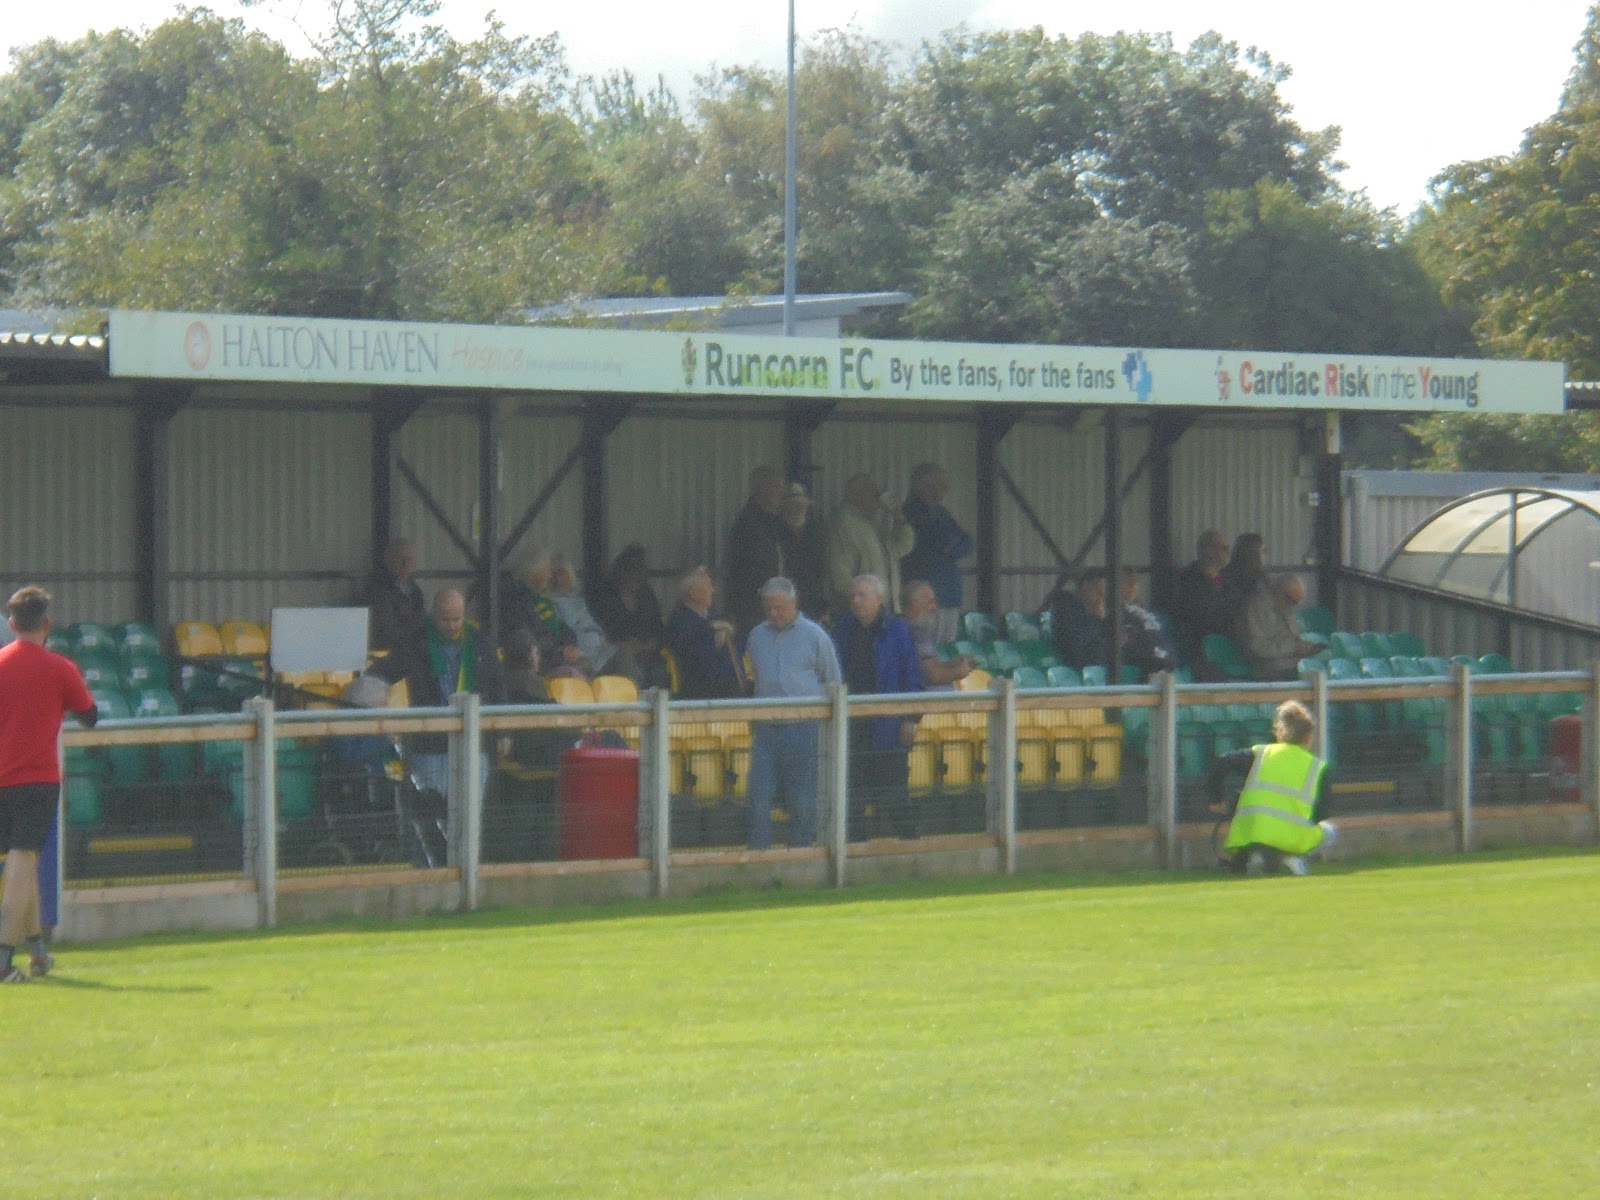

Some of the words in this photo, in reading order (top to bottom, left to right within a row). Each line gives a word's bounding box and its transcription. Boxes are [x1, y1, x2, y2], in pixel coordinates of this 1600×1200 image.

[222, 324, 338, 370] HALTON
[348, 329, 439, 373] HAVEN
[705, 342, 828, 388] Runcorn
[890, 357, 914, 391] By
[920, 357, 951, 386] the
[958, 357, 1003, 392] fans,
[1009, 359, 1036, 387] for
[1041, 361, 1071, 388] the
[1076, 361, 1115, 389] fans
[1239, 360, 1319, 396] Cardiac
[1325, 363, 1370, 398] Risk
[1390, 367, 1416, 399] the
[1419, 366, 1479, 408] Young
